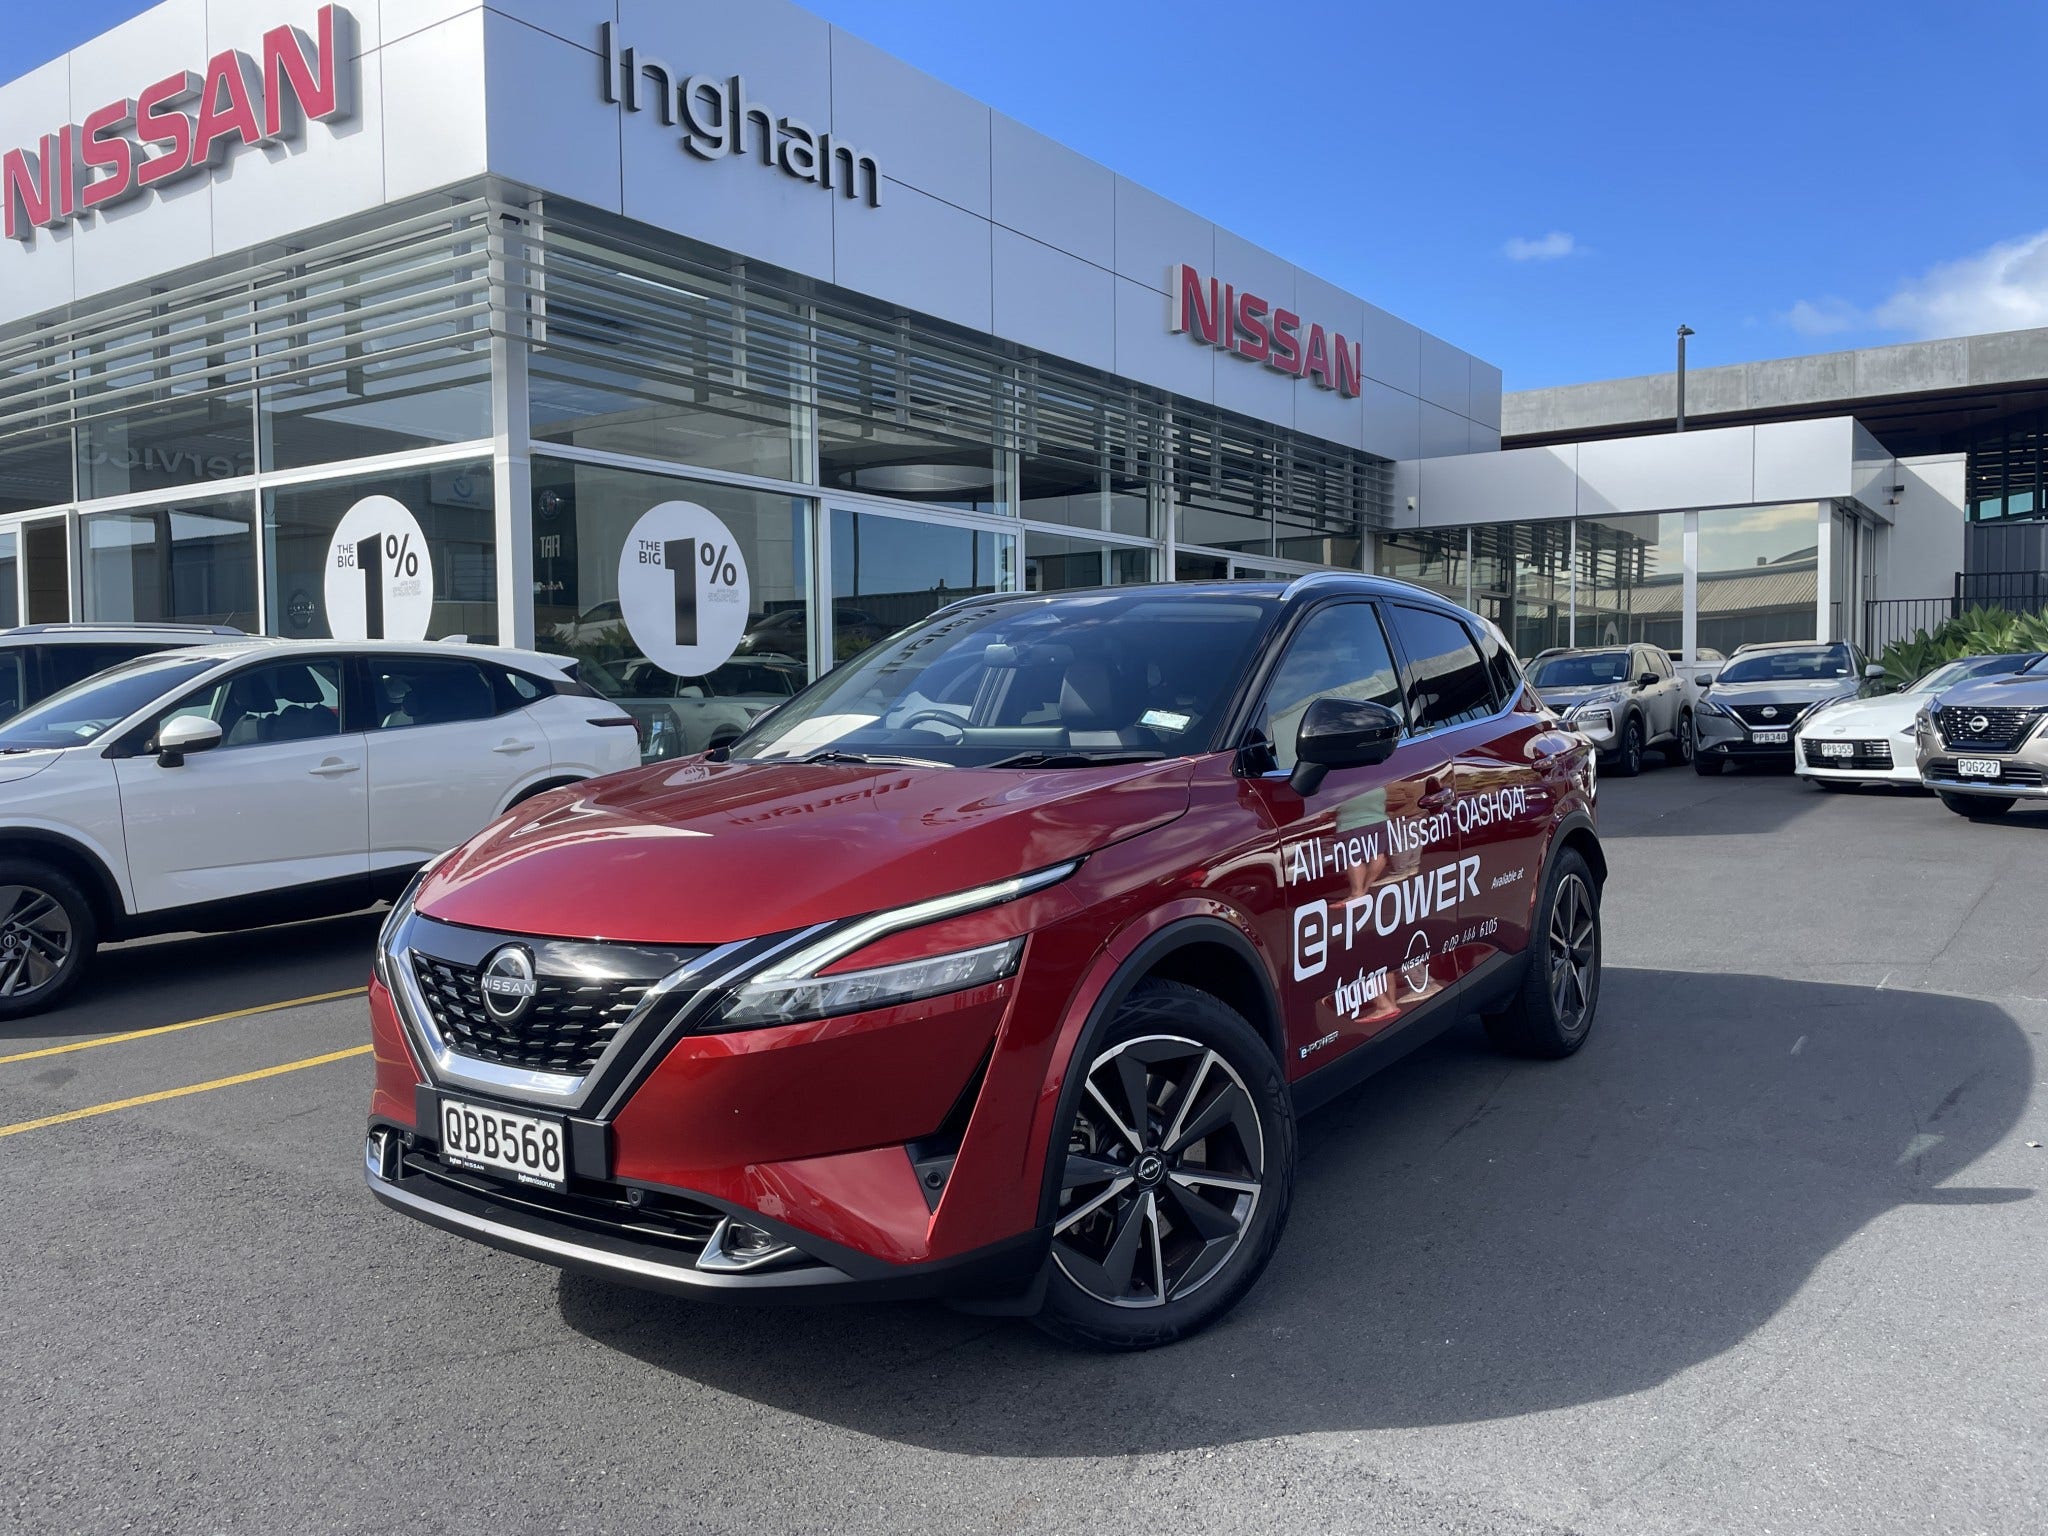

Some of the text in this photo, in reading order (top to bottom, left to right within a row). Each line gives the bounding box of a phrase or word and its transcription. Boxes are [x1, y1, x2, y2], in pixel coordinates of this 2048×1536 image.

[3, 2, 343, 240] NISSAN
[600, 21, 883, 208] Ingham
[1172, 263, 1361, 399] NISSAN
[337, 544, 354, 555] THE
[638, 540, 661, 552] THE
[337, 555, 355, 568] BIG
[638, 551, 661, 565] BIG
[1754, 733, 1787, 741] PPB348
[1959, 760, 1999, 774] PQG227
[1292, 785, 1527, 886] All-new Nissan QASHQAI
[1491, 867, 1524, 889] Available at
[1294, 854, 1481, 982] e-POWER
[1480, 916, 1498, 938] 6105
[1401, 951, 1431, 973] NISSAN
[481, 976, 535, 994] NISSAN
[1301, 1031, 1339, 1058] e-POWER
[446, 1107, 560, 1173] QBB568
